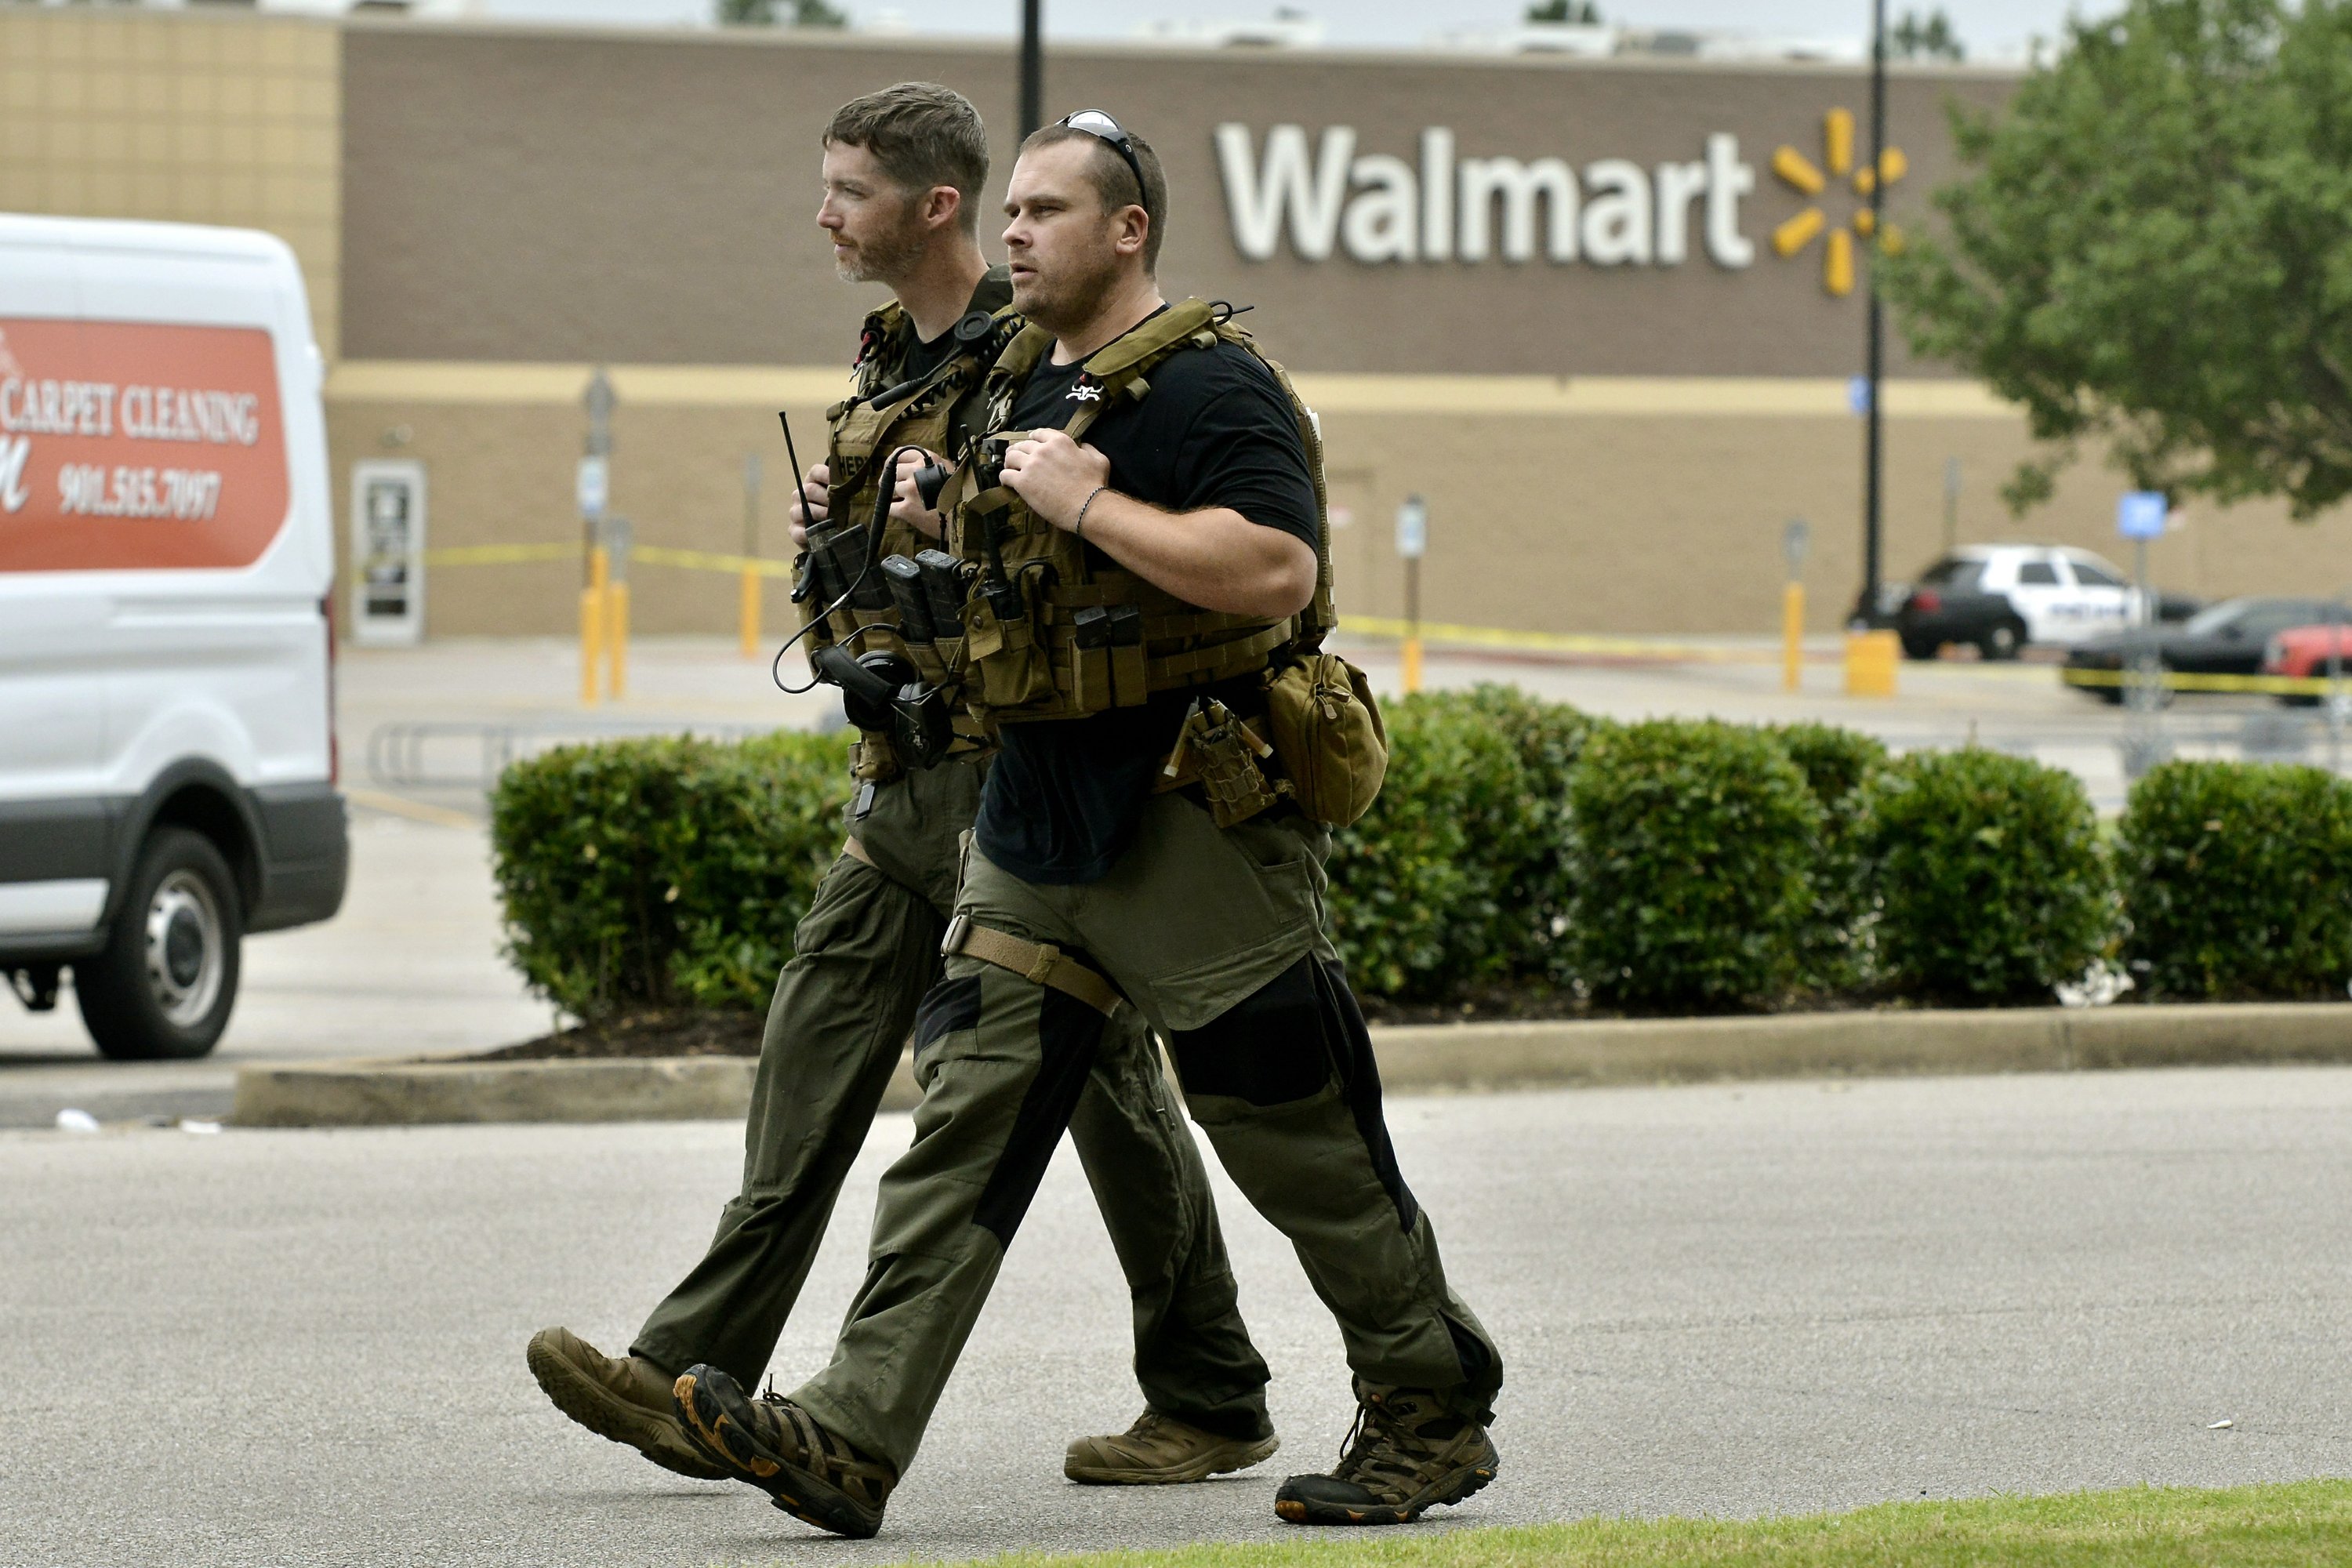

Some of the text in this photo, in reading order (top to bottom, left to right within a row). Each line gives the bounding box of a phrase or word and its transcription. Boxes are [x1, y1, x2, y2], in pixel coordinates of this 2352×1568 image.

[1215, 122, 1755, 268] Walmart
[1, 377, 259, 446] CARPET CLEANING
[58, 463, 221, 521] 901.515.7097
